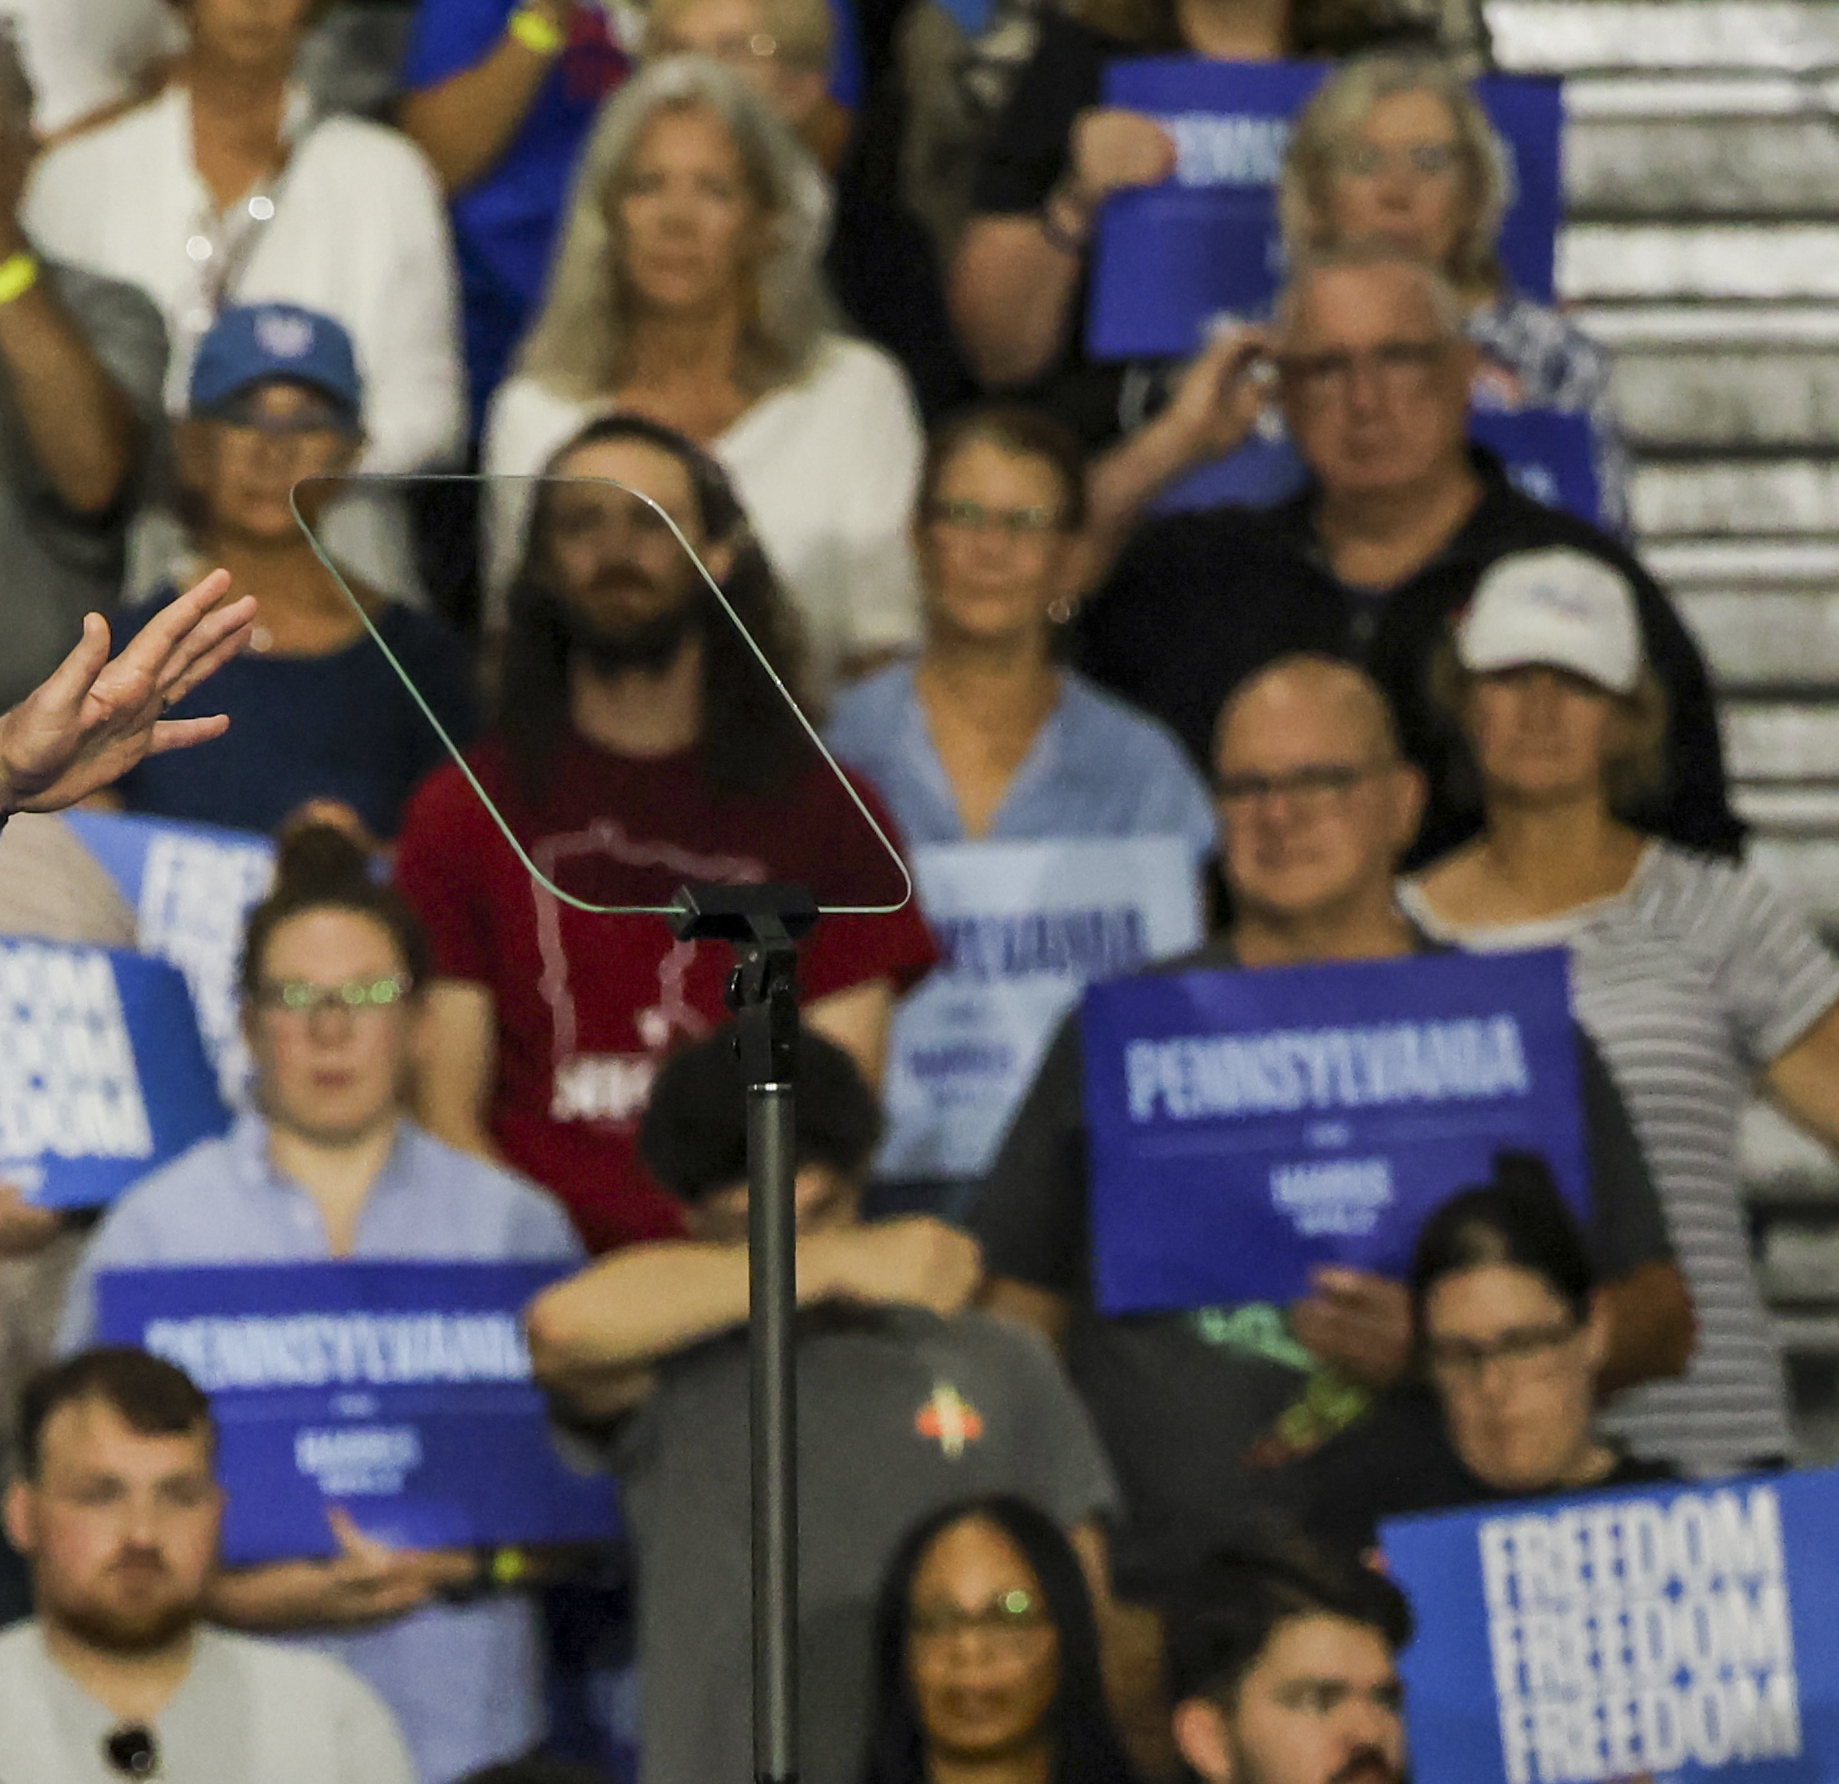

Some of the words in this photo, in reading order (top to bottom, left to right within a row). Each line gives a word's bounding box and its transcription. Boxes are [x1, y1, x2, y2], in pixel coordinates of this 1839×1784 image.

[1124, 1013, 1529, 1124] PENNSYLVANIA
[1479, 1485, 1786, 1610] FREEDOM
[1490, 1573, 1796, 1700] FREEDOM
